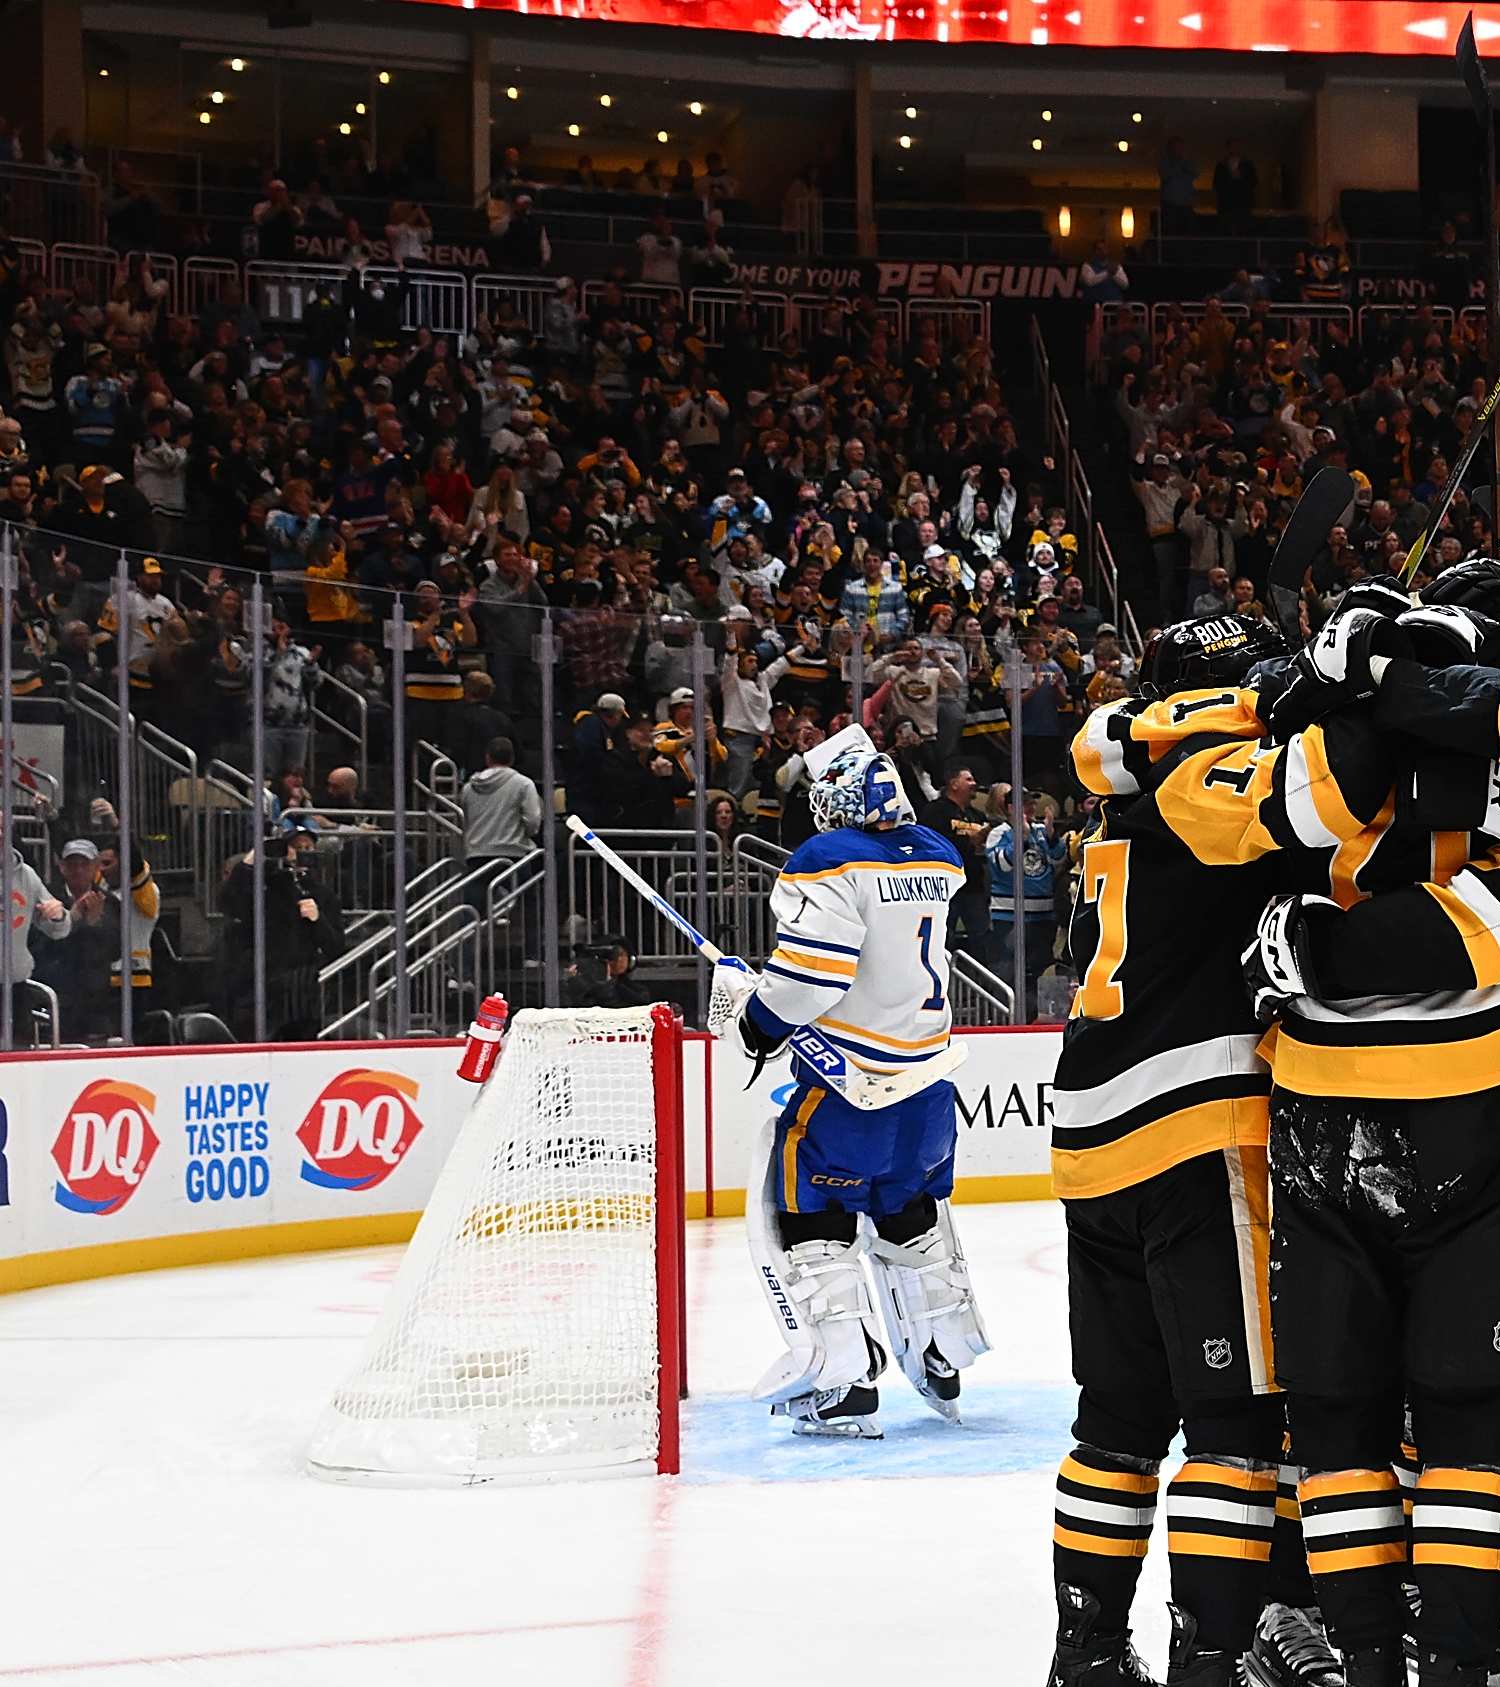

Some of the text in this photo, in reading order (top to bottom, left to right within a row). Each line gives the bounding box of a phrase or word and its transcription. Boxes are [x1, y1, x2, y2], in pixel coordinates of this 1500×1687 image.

[294, 234, 490, 267] PAIS RENA
[724, 261, 1083, 298] OME OF YOUR PENGUIN
[264, 285, 304, 320] 11
[1193, 618, 1245, 646] BOLD
[1203, 634, 1248, 654] PENGUIN
[1083, 839, 1131, 1022] 7
[916, 915, 947, 1013] 1
[793, 1029, 842, 1071] UER
[184, 1081, 271, 1121] HAPPY
[68, 1107, 146, 1185] DQ
[185, 1120, 270, 1155] TASTES
[315, 1094, 404, 1165] DQ
[184, 1156, 271, 1203] GOOD
[811, 1174, 863, 1187] CCM
[761, 1264, 799, 1331] BAUER
